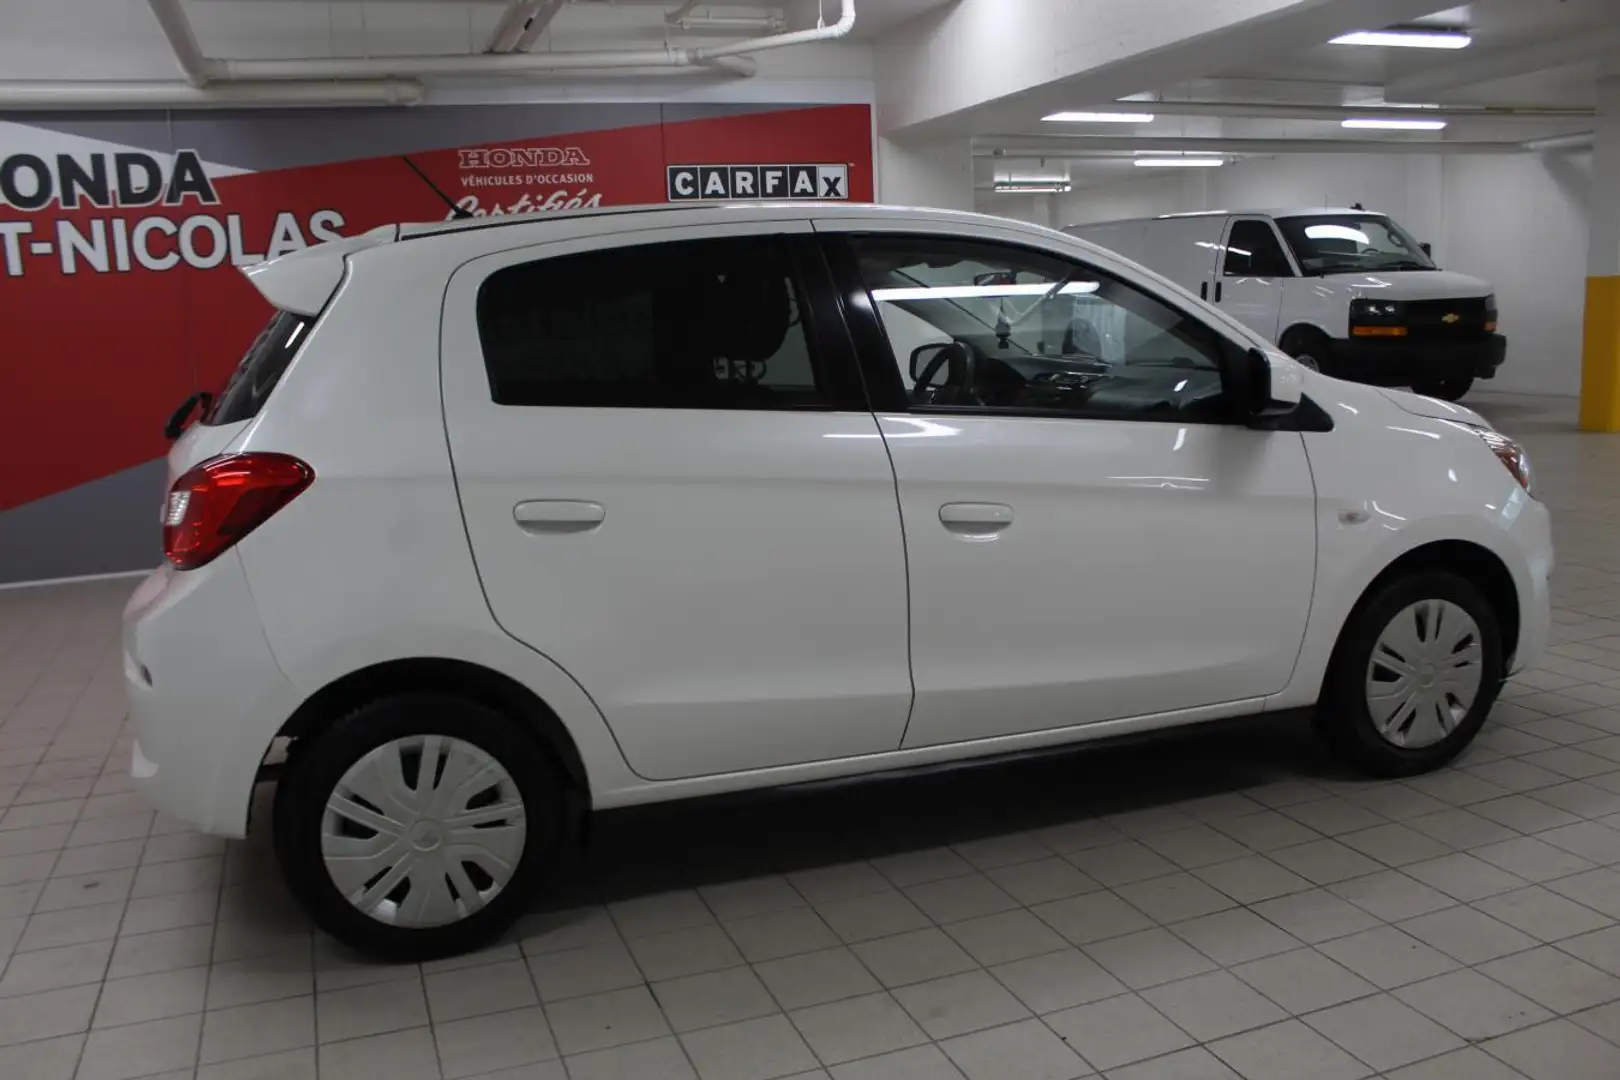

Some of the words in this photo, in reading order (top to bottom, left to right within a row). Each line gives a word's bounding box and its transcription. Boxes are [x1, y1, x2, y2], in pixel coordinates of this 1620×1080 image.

[458, 147, 590, 168] HONDA
[461, 174, 522, 186] VÉHICULES
[526, 173, 594, 185] D'OCCASION
[674, 171, 841, 197] CARFAX
